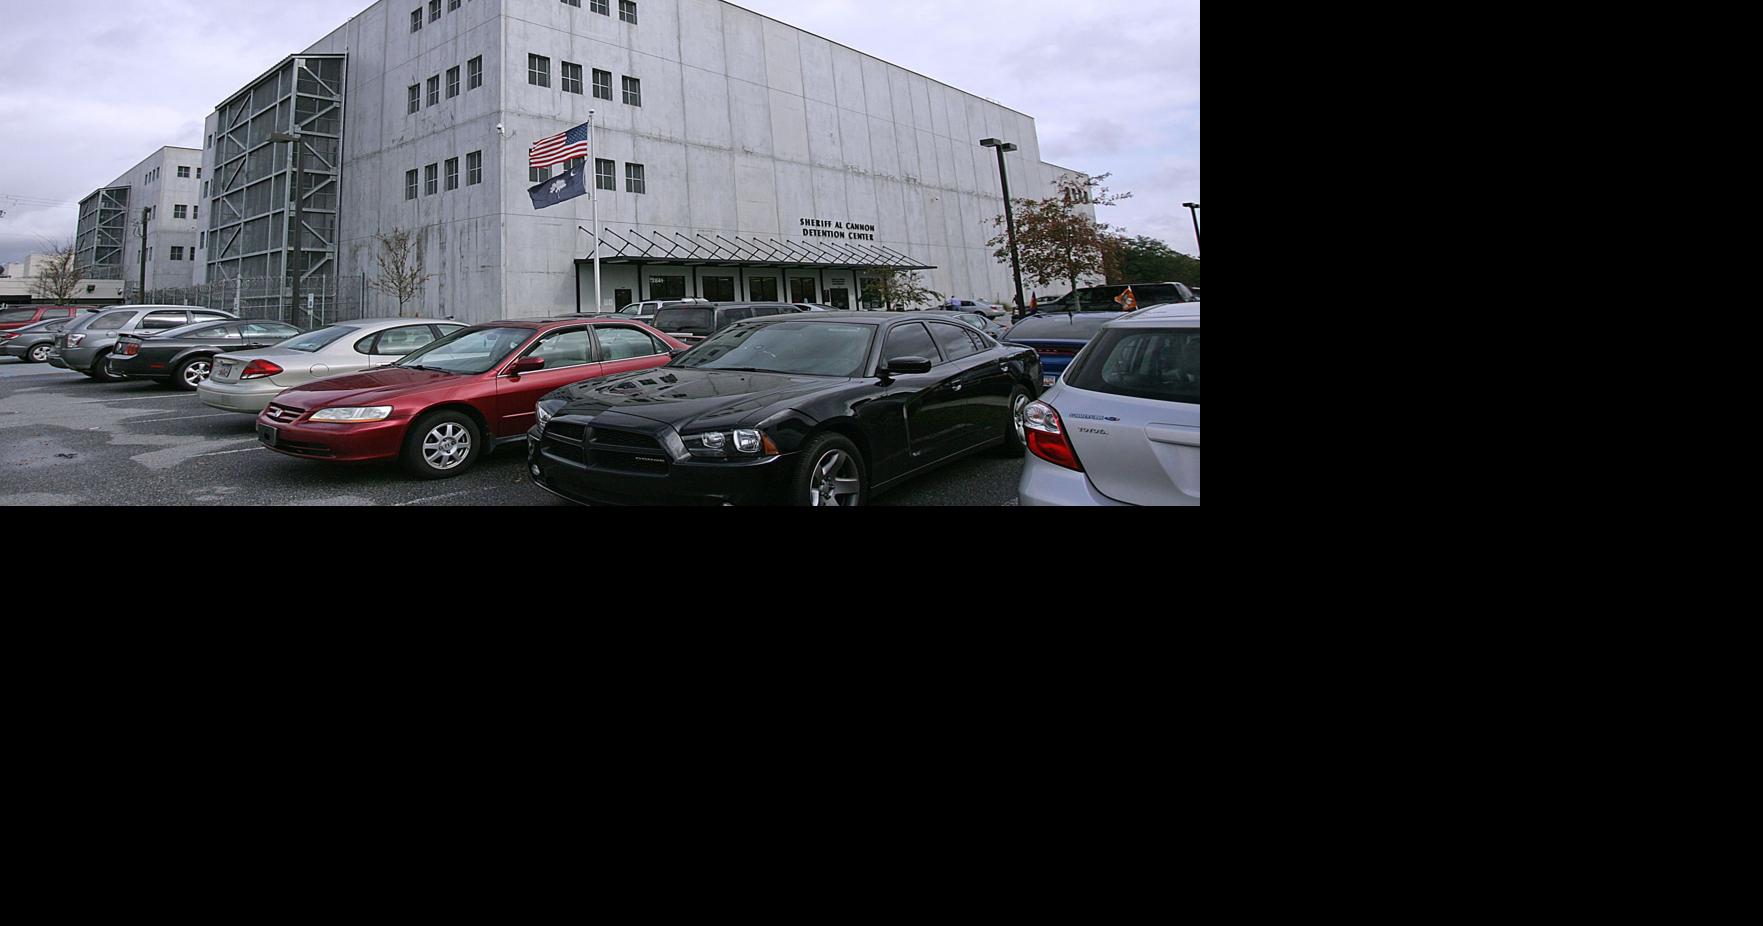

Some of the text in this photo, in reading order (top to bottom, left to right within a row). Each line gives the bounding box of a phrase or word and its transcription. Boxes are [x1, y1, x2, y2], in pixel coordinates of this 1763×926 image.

[800, 218, 875, 232] SHERIFF AL CANNON
[802, 228, 874, 241] DETENTION CENTER
